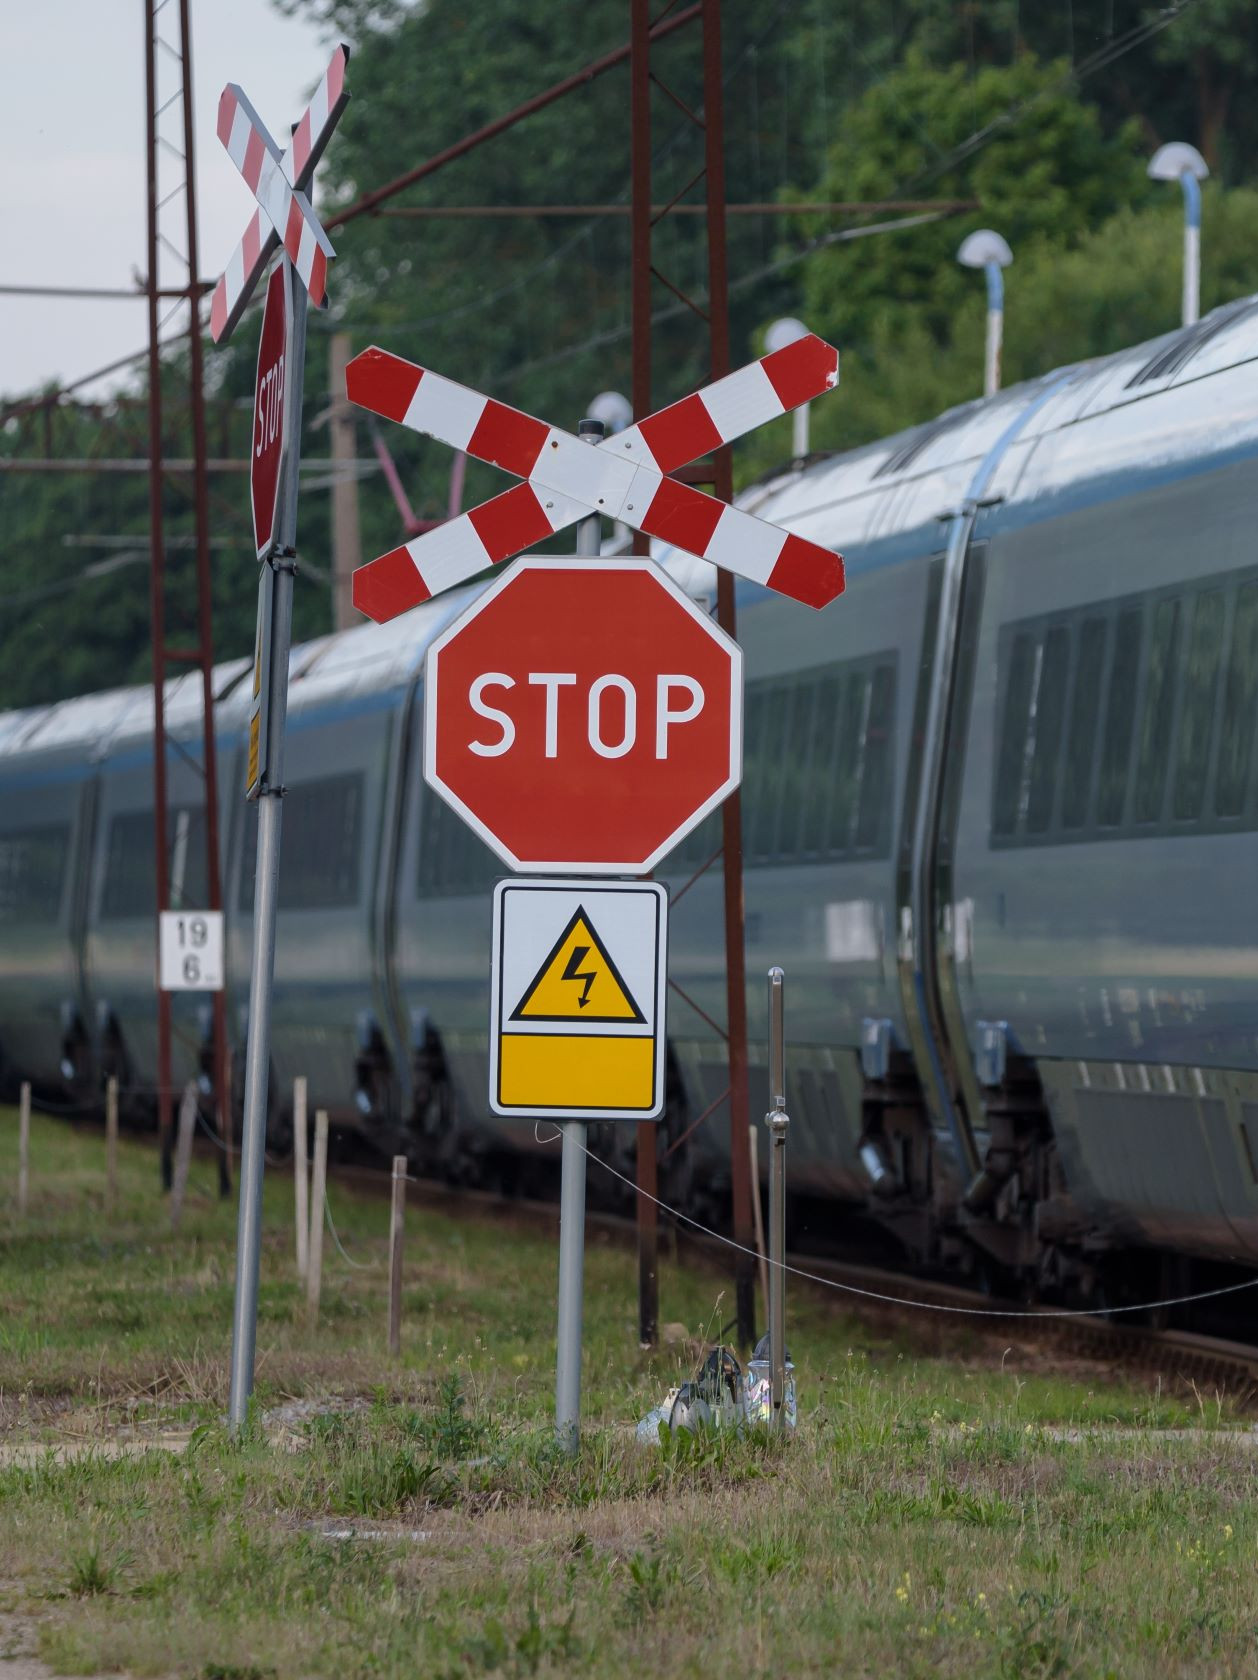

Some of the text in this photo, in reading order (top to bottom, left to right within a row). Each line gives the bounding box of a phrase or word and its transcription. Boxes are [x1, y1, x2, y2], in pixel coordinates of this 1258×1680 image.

[256, 354, 285, 458] STOP
[467, 671, 706, 760] STOP
[177, 917, 208, 949] 19
[182, 952, 201, 985] 6
